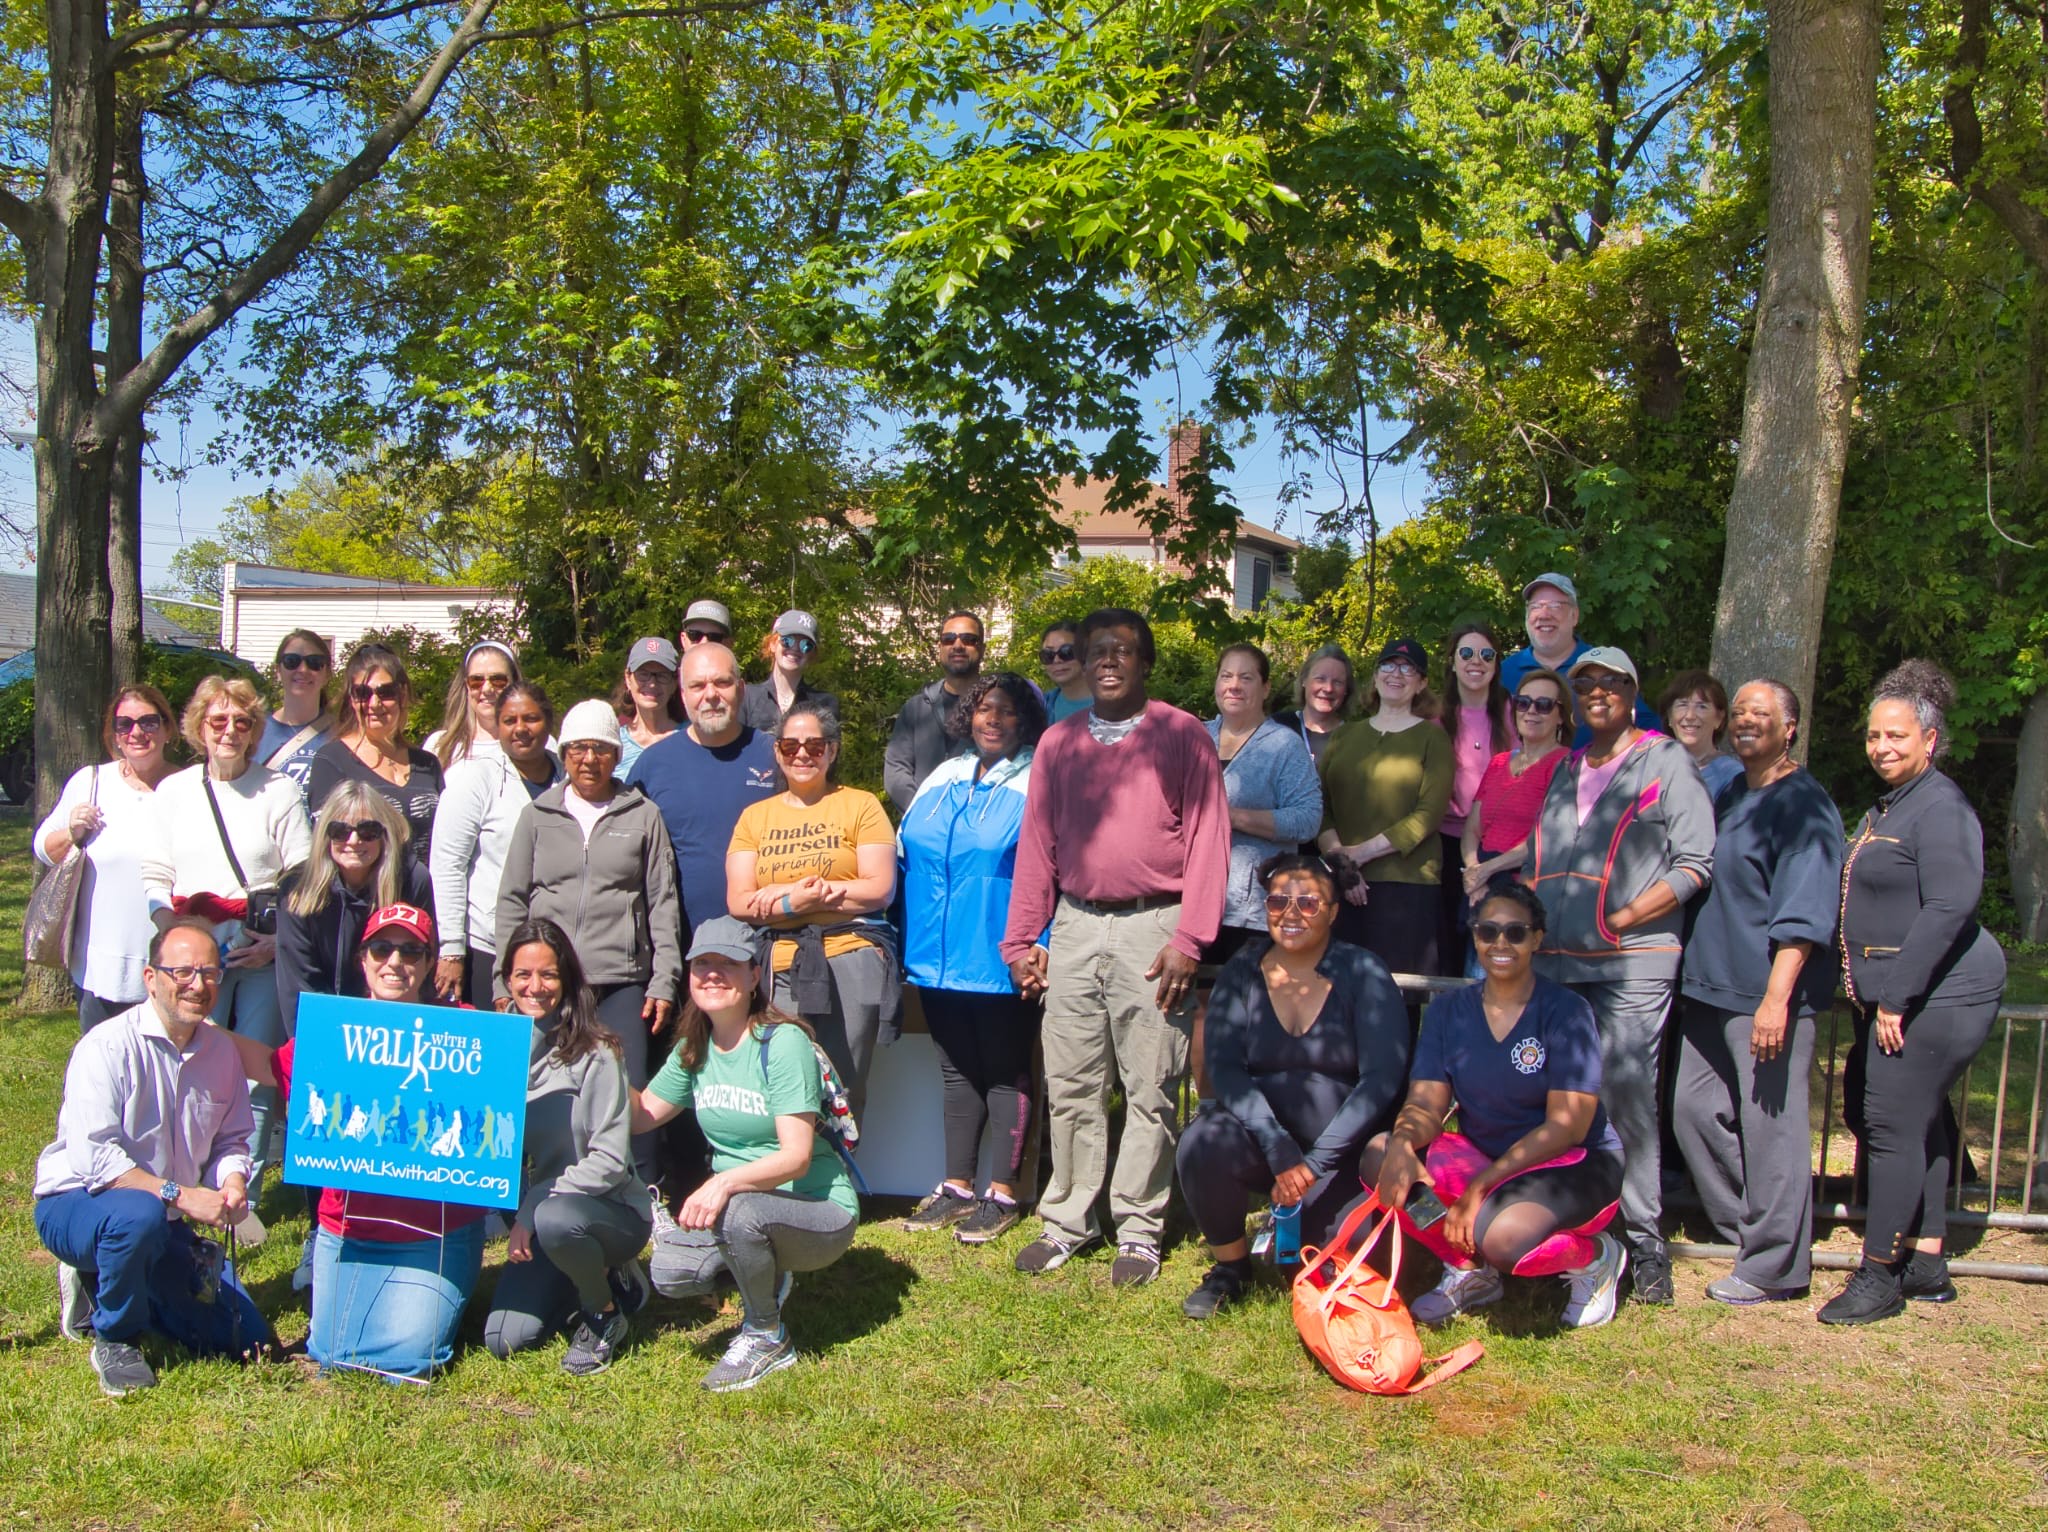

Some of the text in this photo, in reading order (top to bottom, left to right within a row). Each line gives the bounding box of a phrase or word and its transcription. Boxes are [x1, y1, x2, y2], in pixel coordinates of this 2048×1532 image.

[769, 822, 826, 840] make
[757, 834, 842, 857] ourself
[759, 851, 837, 883] a priority
[471, 1037, 482, 1050] a
[428, 1046, 482, 1075] DOC
[294, 1154, 510, 1198] www.WALKwithaDOC.org
